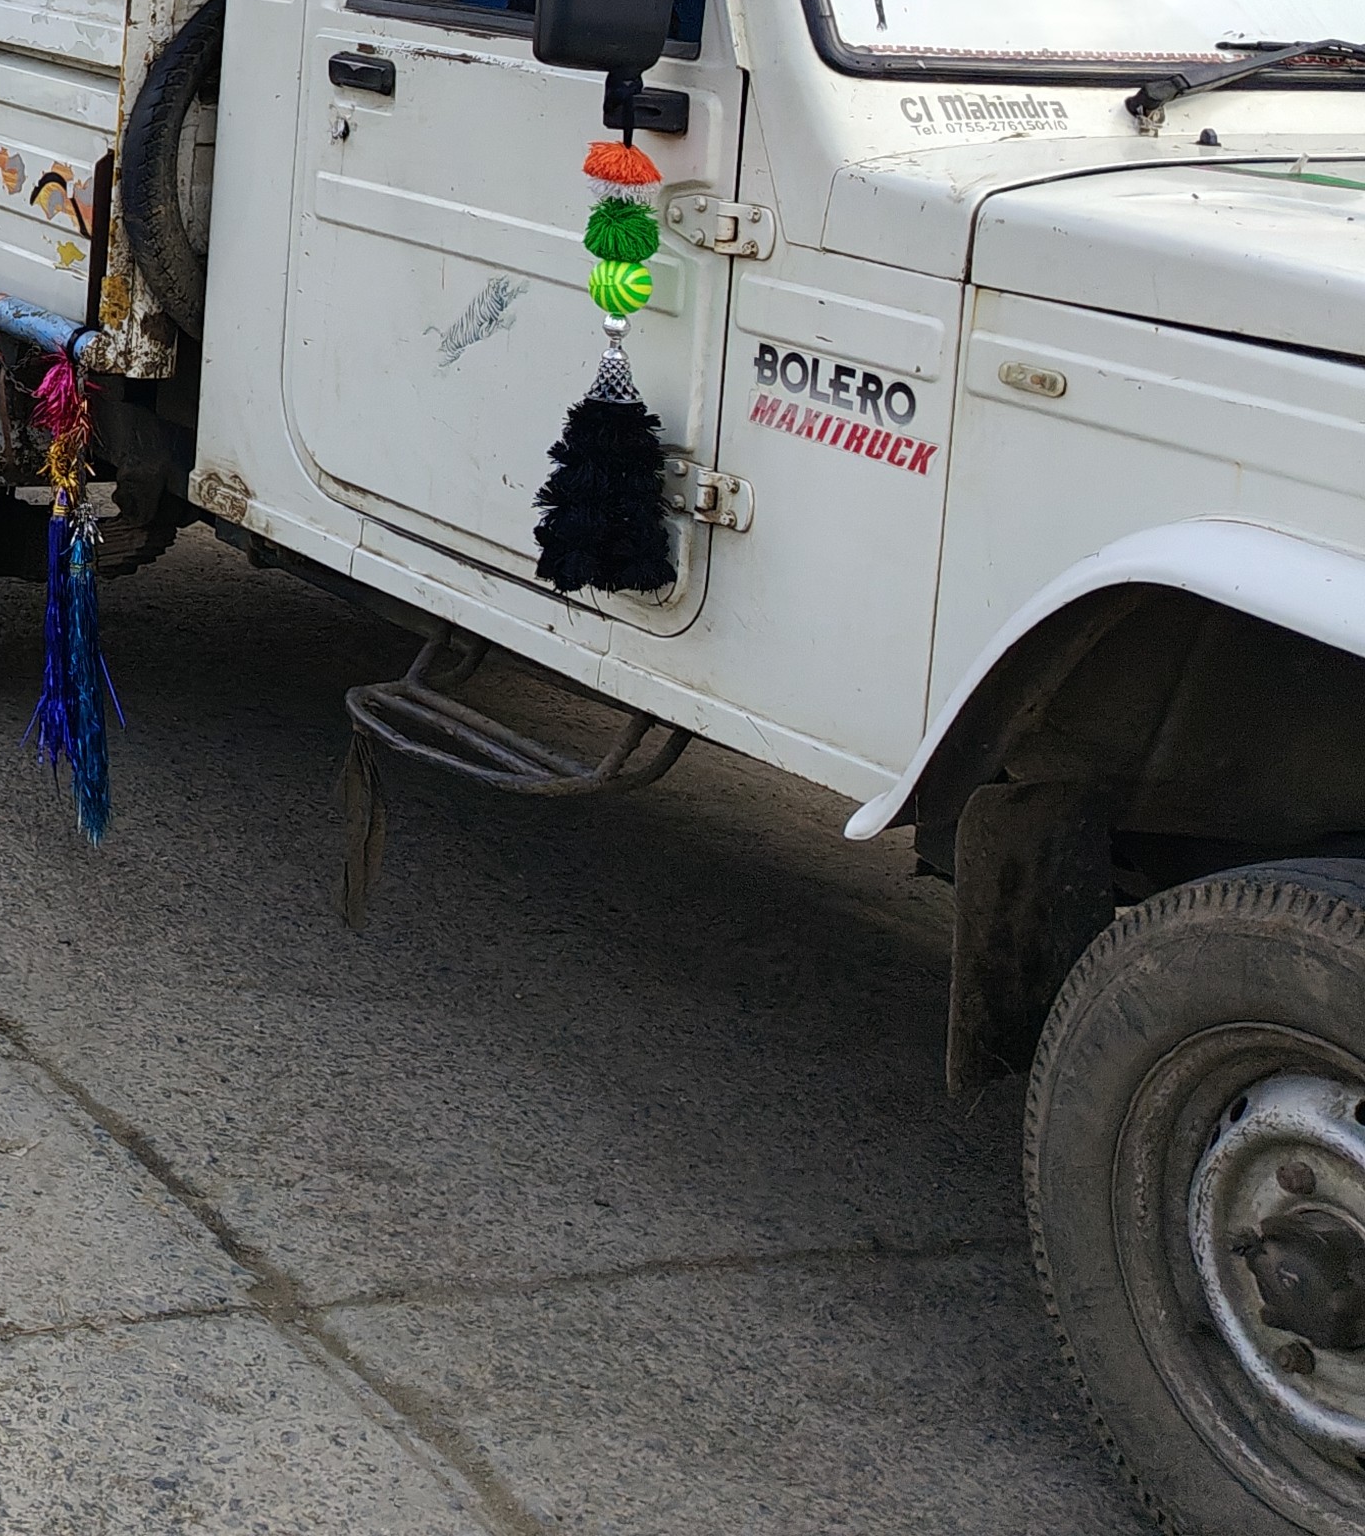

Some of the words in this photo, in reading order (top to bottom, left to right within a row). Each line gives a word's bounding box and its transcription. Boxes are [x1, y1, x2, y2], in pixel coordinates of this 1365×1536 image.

[910, 125, 943, 136] Tel.
[937, 93, 1069, 122] Mahindra
[753, 342, 917, 428] BOLERO
[749, 393, 939, 475] MAXITRUCK
